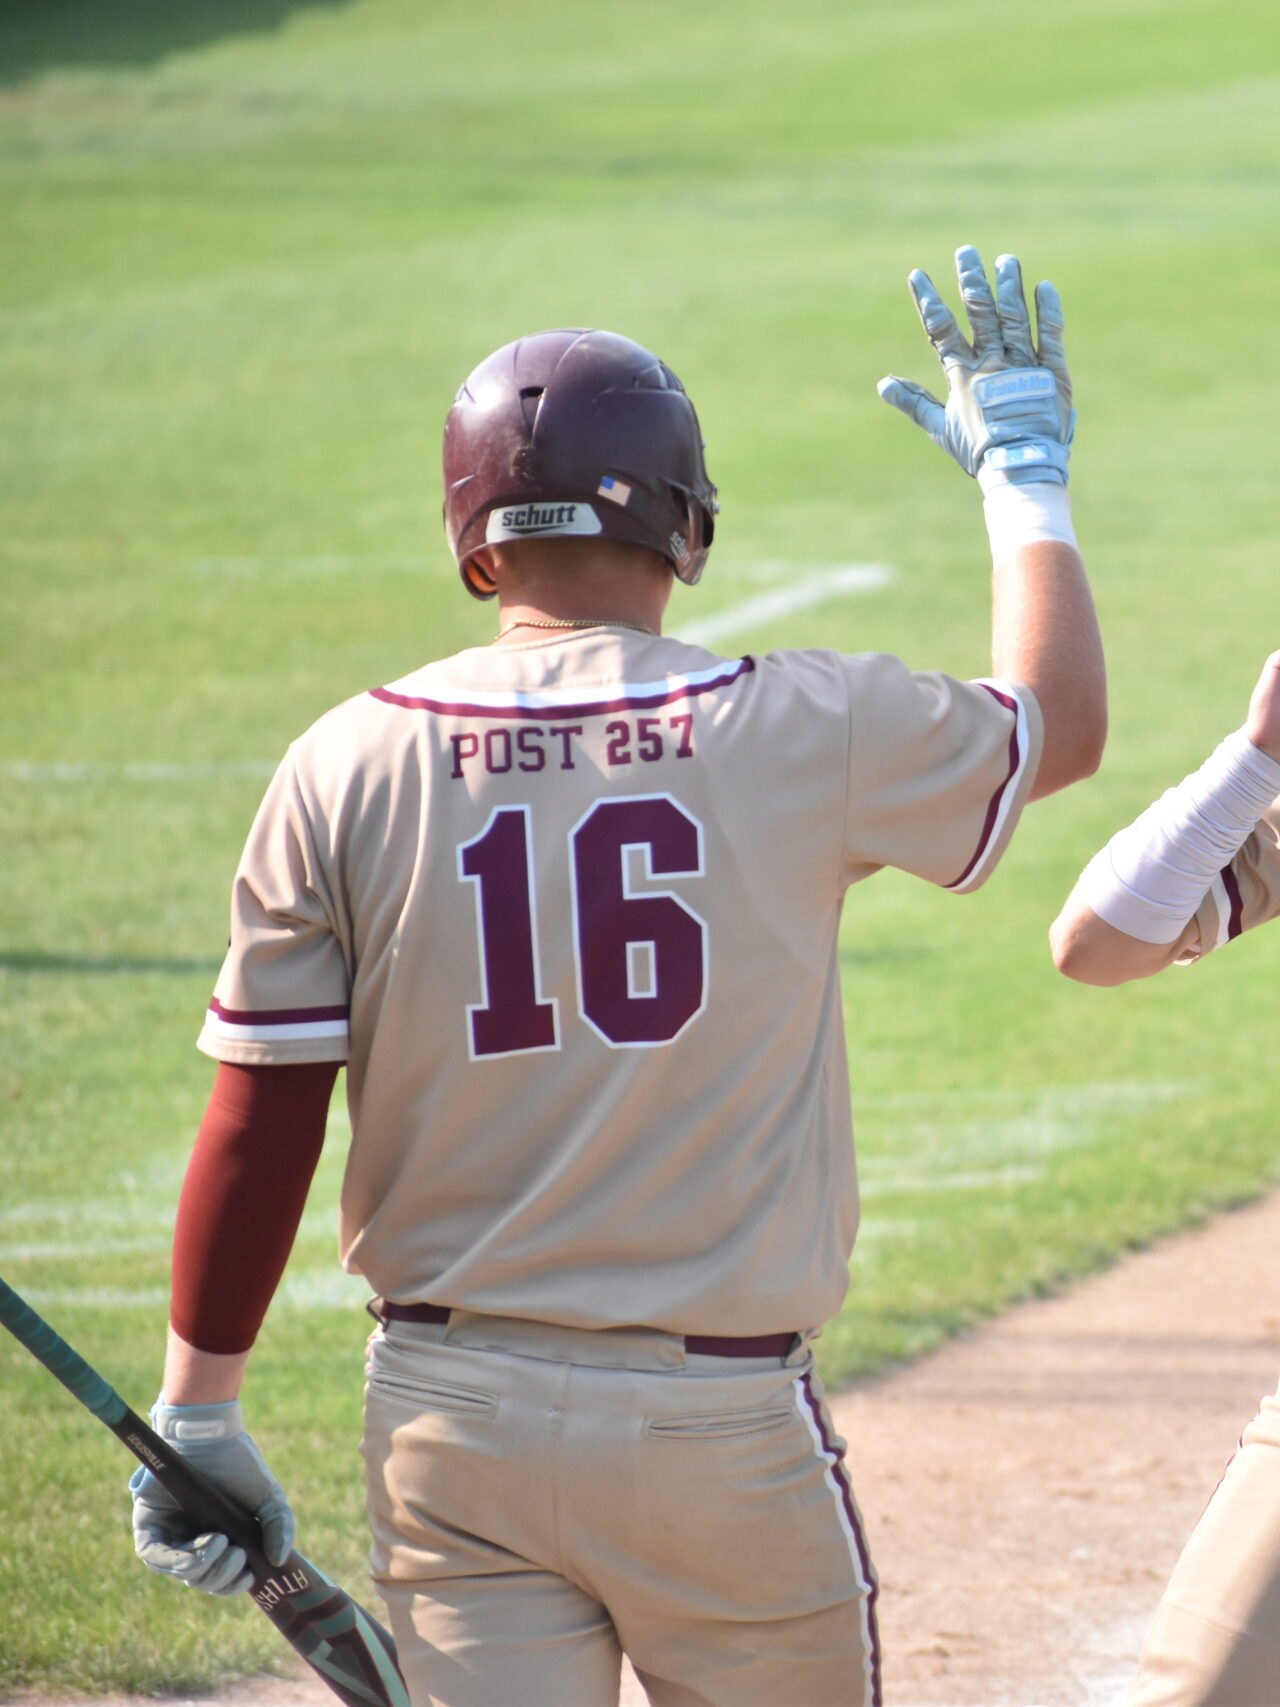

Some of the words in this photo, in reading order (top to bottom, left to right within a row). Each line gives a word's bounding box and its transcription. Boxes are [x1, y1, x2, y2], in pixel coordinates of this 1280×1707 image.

[502, 504, 576, 527] schutt
[450, 725, 583, 779] POST
[605, 713, 694, 766] 257
[456, 792, 709, 1062] 16
[127, 1433, 166, 1471] LOUISVILLE
[254, 1568, 309, 1611] ATLAS
